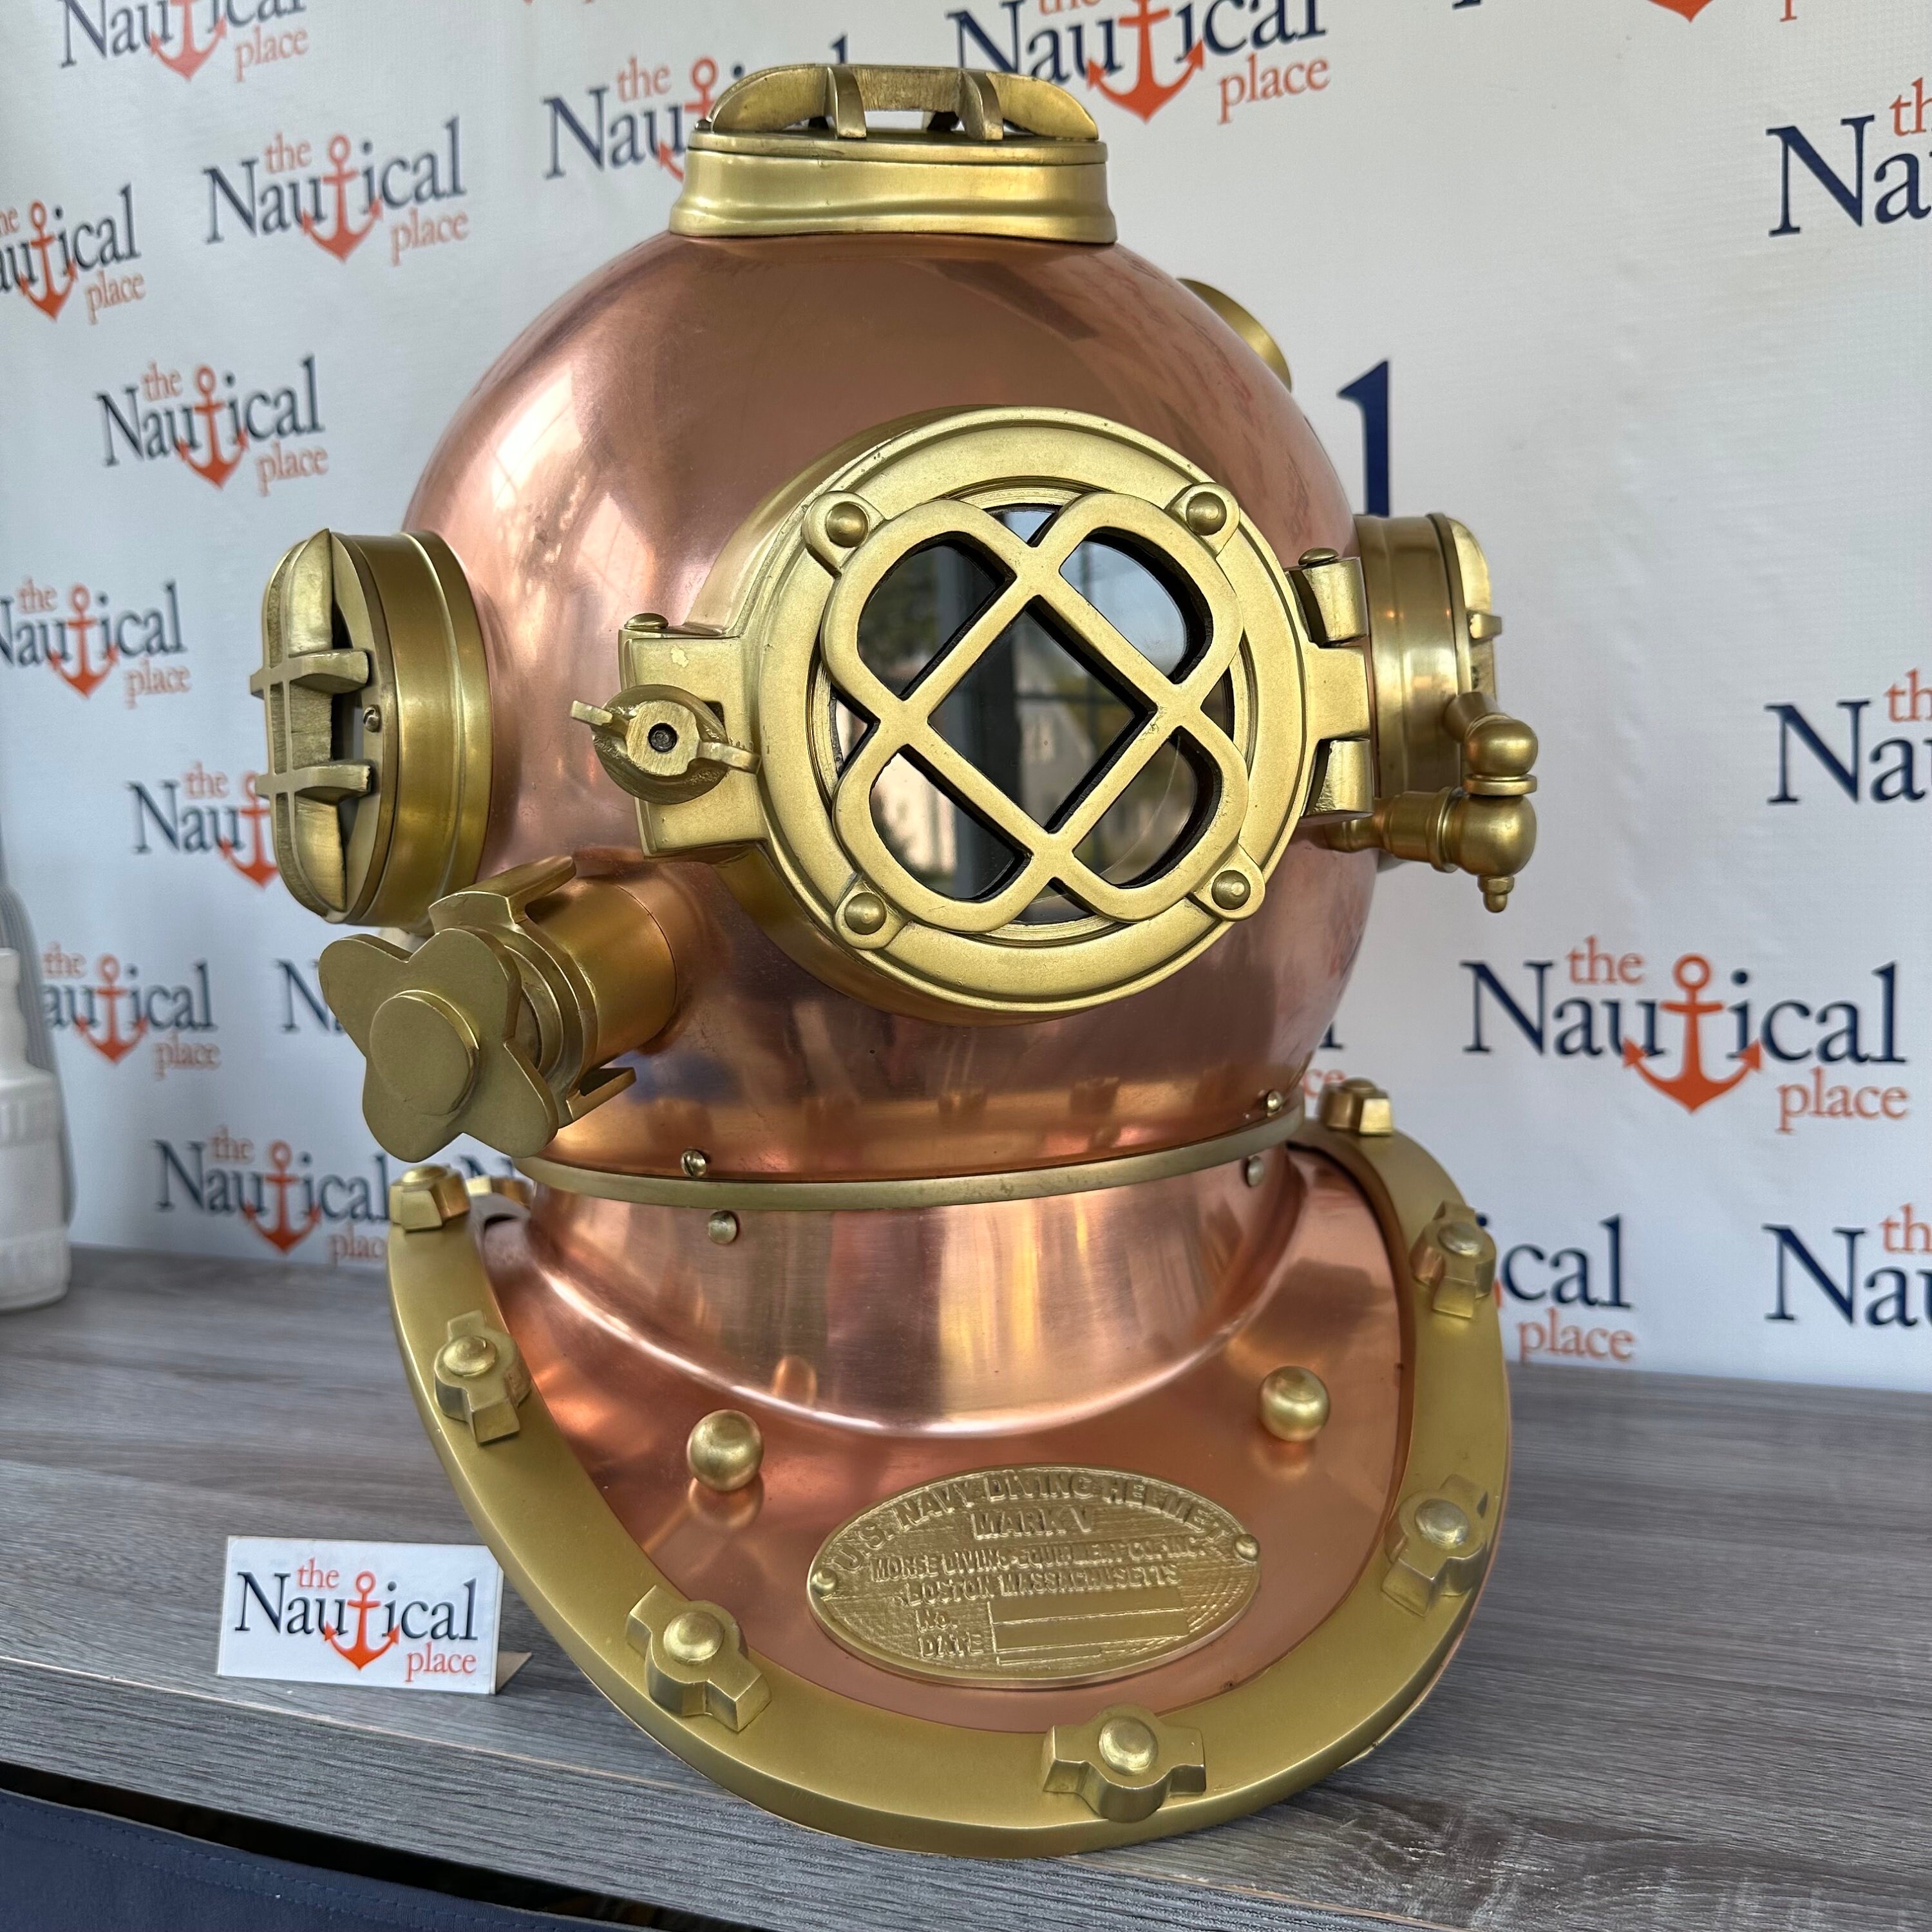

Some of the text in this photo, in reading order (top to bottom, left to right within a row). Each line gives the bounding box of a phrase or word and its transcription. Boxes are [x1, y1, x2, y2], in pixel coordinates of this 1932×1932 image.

[234, 26, 309, 84] place
[616, 55, 672, 103] the
[1217, 52, 1330, 125] place
[1888, 76, 1932, 137] th
[264, 132, 312, 175] the
[202, 115, 468, 263] Nautical
[390, 206, 471, 267] place
[84, 269, 147, 325] place
[140, 362, 183, 403] the
[95, 354, 327, 491] Nautical
[257, 440, 330, 498] place
[16, 574, 57, 614] the
[0, 579, 188, 699] autical
[122, 652, 191, 709] place
[1882, 667, 1932, 723] th
[184, 761, 230, 799] the
[42, 941, 86, 979] the
[1566, 934, 1645, 986] the
[40, 958, 220, 1065] autical
[1459, 953, 1908, 1114] Nautical
[153, 1030, 222, 1081] place
[1777, 1065, 1910, 1135] place
[211, 1125, 255, 1164] the
[154, 1137, 390, 1255] Nautical
[326, 1222, 388, 1266] plac
[1879, 1202, 1932, 1255] th
[1516, 1307, 1636, 1367] place
[891, 1481, 975, 1531] NAVY
[982, 1472, 1095, 1502] DIVING
[1100, 1475, 1235, 1544] HELMET
[970, 1505, 1093, 1540] MARK V
[297, 1557, 340, 1589] the
[903, 1562, 1180, 1607] BOSTON MASSACHUSETTS
[234, 1571, 478, 1669] Nautical
[917, 1633, 984, 1659] DATE
[404, 1642, 477, 1683] place
